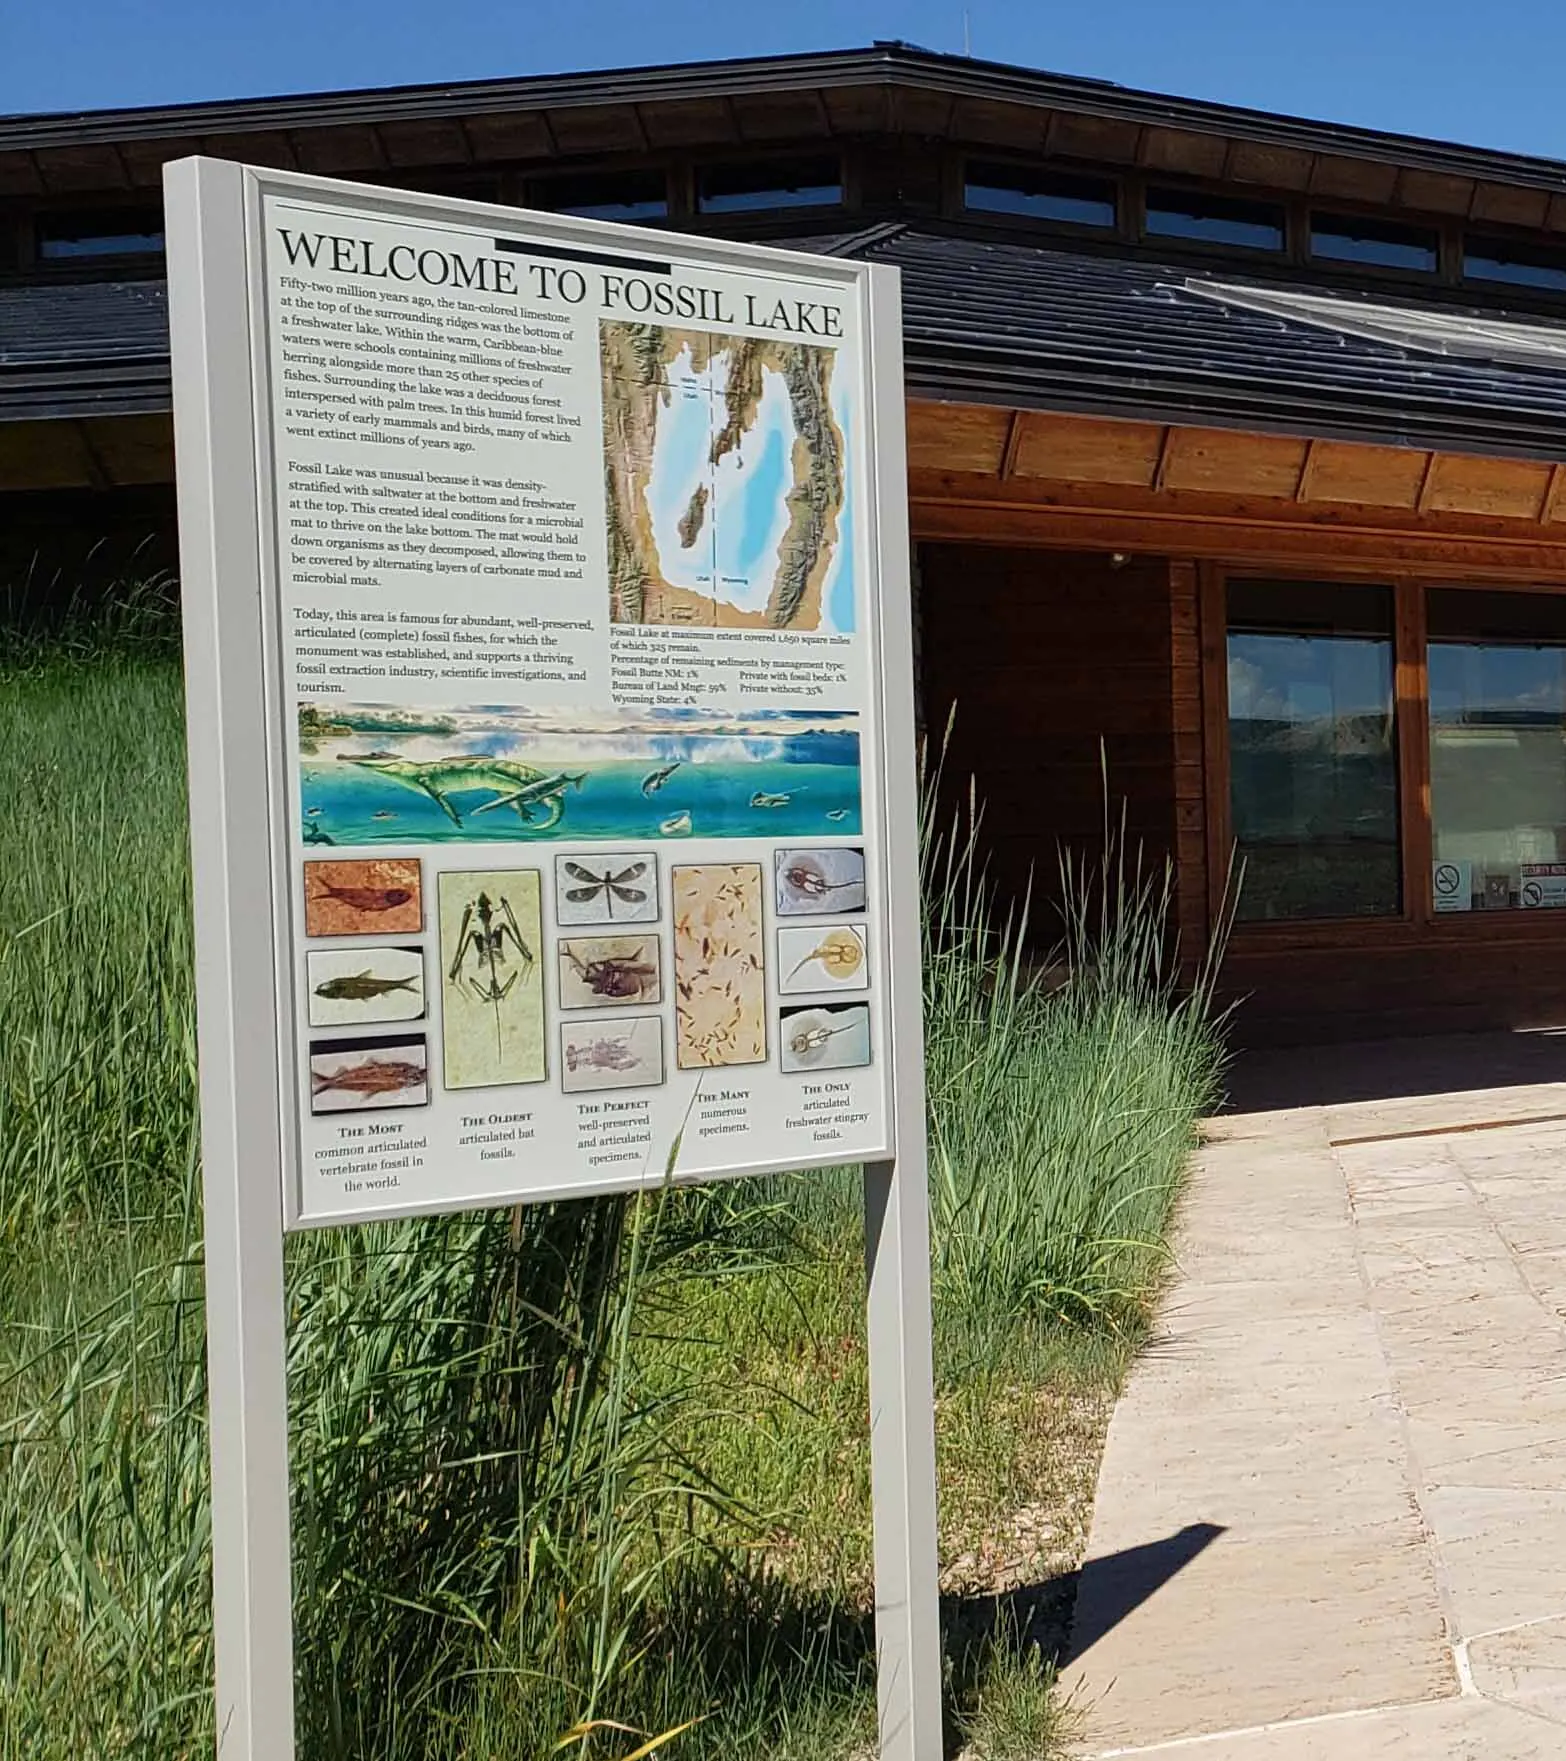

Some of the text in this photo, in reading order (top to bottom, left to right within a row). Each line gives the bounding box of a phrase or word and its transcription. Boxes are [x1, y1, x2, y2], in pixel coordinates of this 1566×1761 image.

[277, 229, 843, 338] WELCOME TO FOSSIL LAKE
[280, 277, 570, 326] Fifty-two million years ago, the tan-colored limestone
[280, 296, 574, 343] at the top of the surrounding ridges was the bottom of
[291, 314, 354, 336] freshwater
[355, 321, 383, 337] lake.
[384, 326, 425, 344] Within
[426, 330, 445, 345] the
[446, 336, 481, 350] warm,
[483, 338, 563, 358] Caribbean-blue
[282, 334, 572, 375] waters were schools containing millions of freshwater
[283, 349, 543, 389] herring alongside more than 25 other species of
[284, 368, 321, 385] fishes.
[323, 373, 397, 395] Surrounding
[398, 380, 417, 396] the
[419, 381, 443, 398] lake
[444, 387, 466, 400] was
[476, 388, 530, 408] deciduous
[532, 394, 562, 409] forest
[285, 387, 581, 427] interspersed with palm trees. In this humid forest lived
[288, 461, 546, 494] Fossil Lake was unusual because it was density-
[293, 608, 594, 632] Today, this area is famous for abundant, well-preserved,
[294, 625, 558, 649] articulated (complete) fossil fishes, for which the
[296, 648, 359, 660] monument
[361, 649, 383, 658] was
[385, 648, 451, 663] established,
[453, 649, 474, 661] and
[475, 651, 522, 664] supports
[532, 652, 574, 666] thriving
[296, 662, 586, 682] fossil extraction industry, scientific investigations, and
[297, 681, 346, 693] tourism.
[701, 1107, 747, 1120] numerous
[803, 1096, 851, 1113] articulated
[579, 1114, 650, 1133] well-preserved
[699, 1123, 750, 1138] specimens.
[786, 1112, 869, 1129] freshwater stingray
[459, 1128, 535, 1145] articulated bat
[578, 1130, 651, 1149] and articulated
[813, 1129, 843, 1141] fossils.
[315, 1136, 427, 1160] common articulated
[481, 1147, 515, 1161] fossils.
[320, 1155, 423, 1176] vertebrate fossil in
[589, 1152, 642, 1167] specimens.
[345, 1176, 400, 1192] the world.
